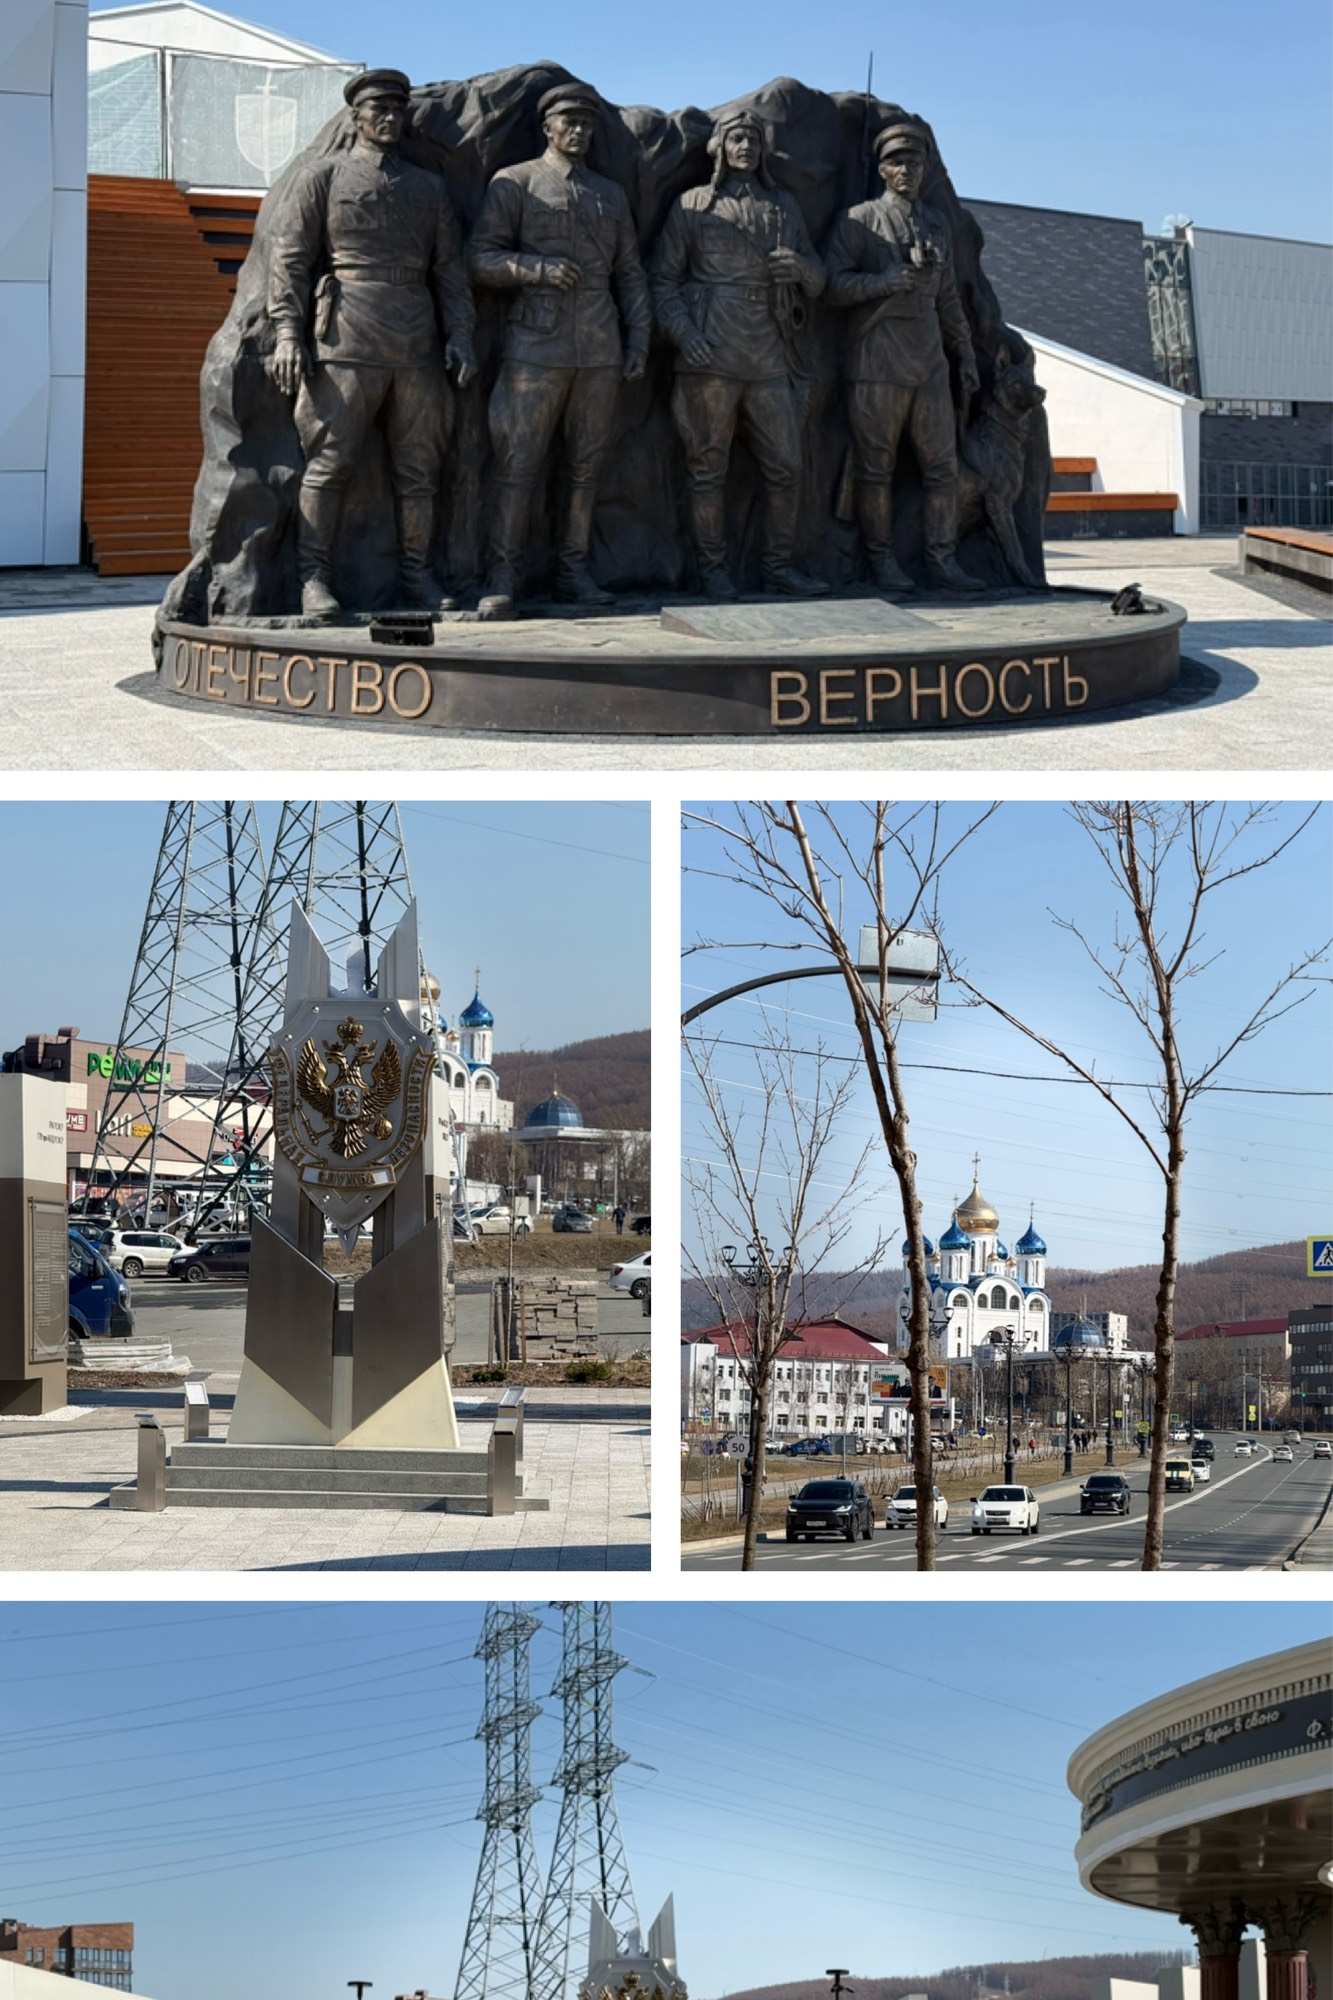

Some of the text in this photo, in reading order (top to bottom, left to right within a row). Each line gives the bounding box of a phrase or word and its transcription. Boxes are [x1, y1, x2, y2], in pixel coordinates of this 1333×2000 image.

[174, 638, 433, 718] ОТЕЧЕСТВО
[770, 656, 1089, 727] ВЕРНОСТЬ
[274, 1058, 305, 1166] ФЕДЕРАЛЬНАЯ
[389, 1056, 426, 1164] БЕЗОПАСНОСТИ
[318, 1171, 376, 1185] СЛУЖБА
[732, 1443, 745, 1453] 50
[1244, 1710, 1280, 1730] свою
